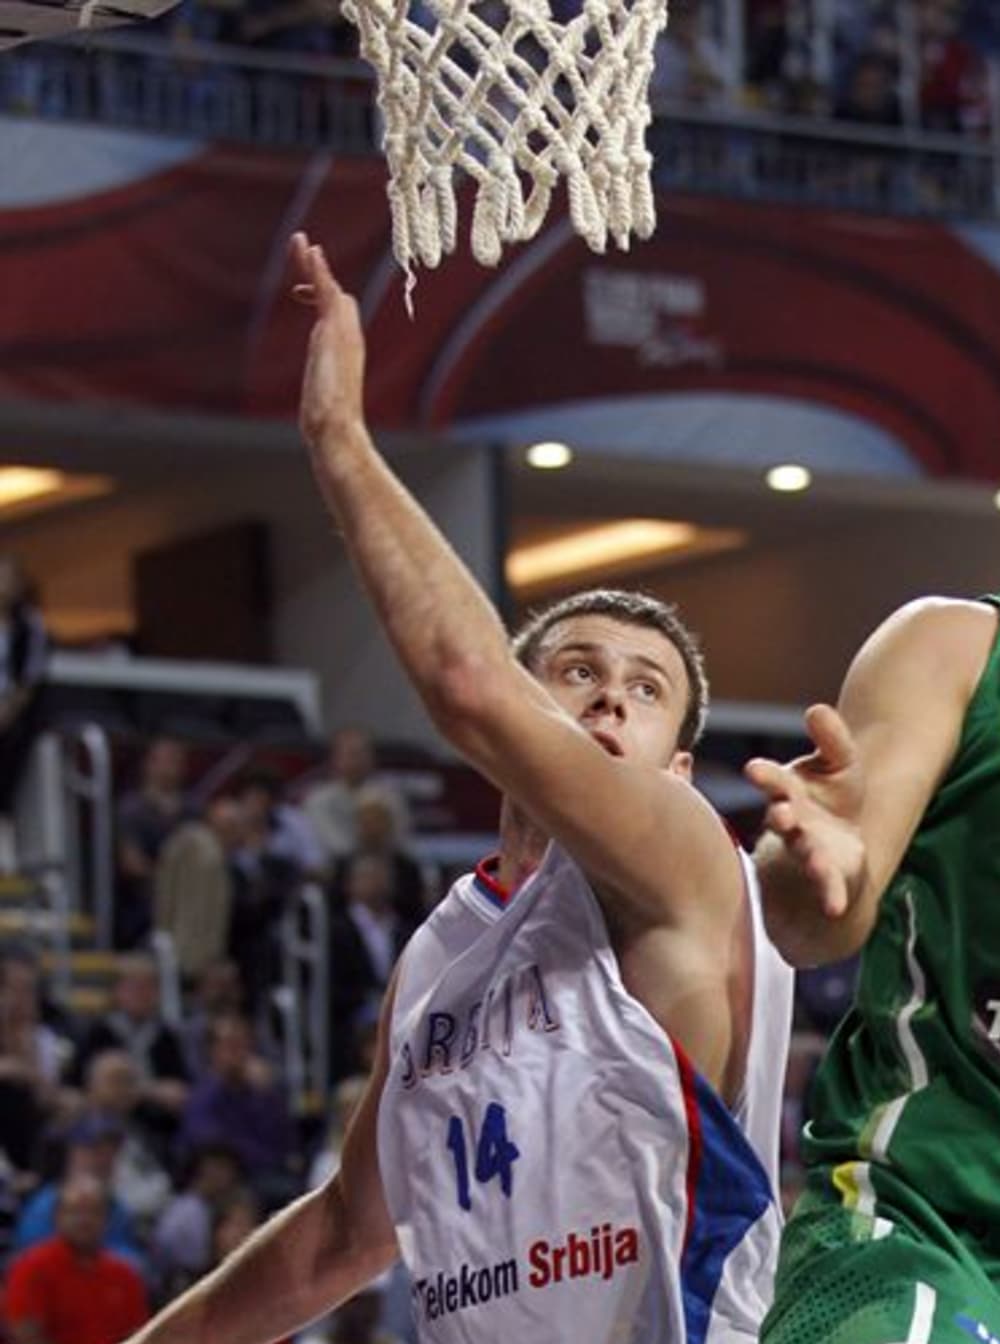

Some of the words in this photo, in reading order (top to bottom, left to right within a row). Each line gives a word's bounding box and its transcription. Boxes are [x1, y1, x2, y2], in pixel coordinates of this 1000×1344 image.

[446, 1101, 520, 1212] 14
[412, 1257, 519, 1322] Telekom
[528, 1222, 640, 1289] Srbija
